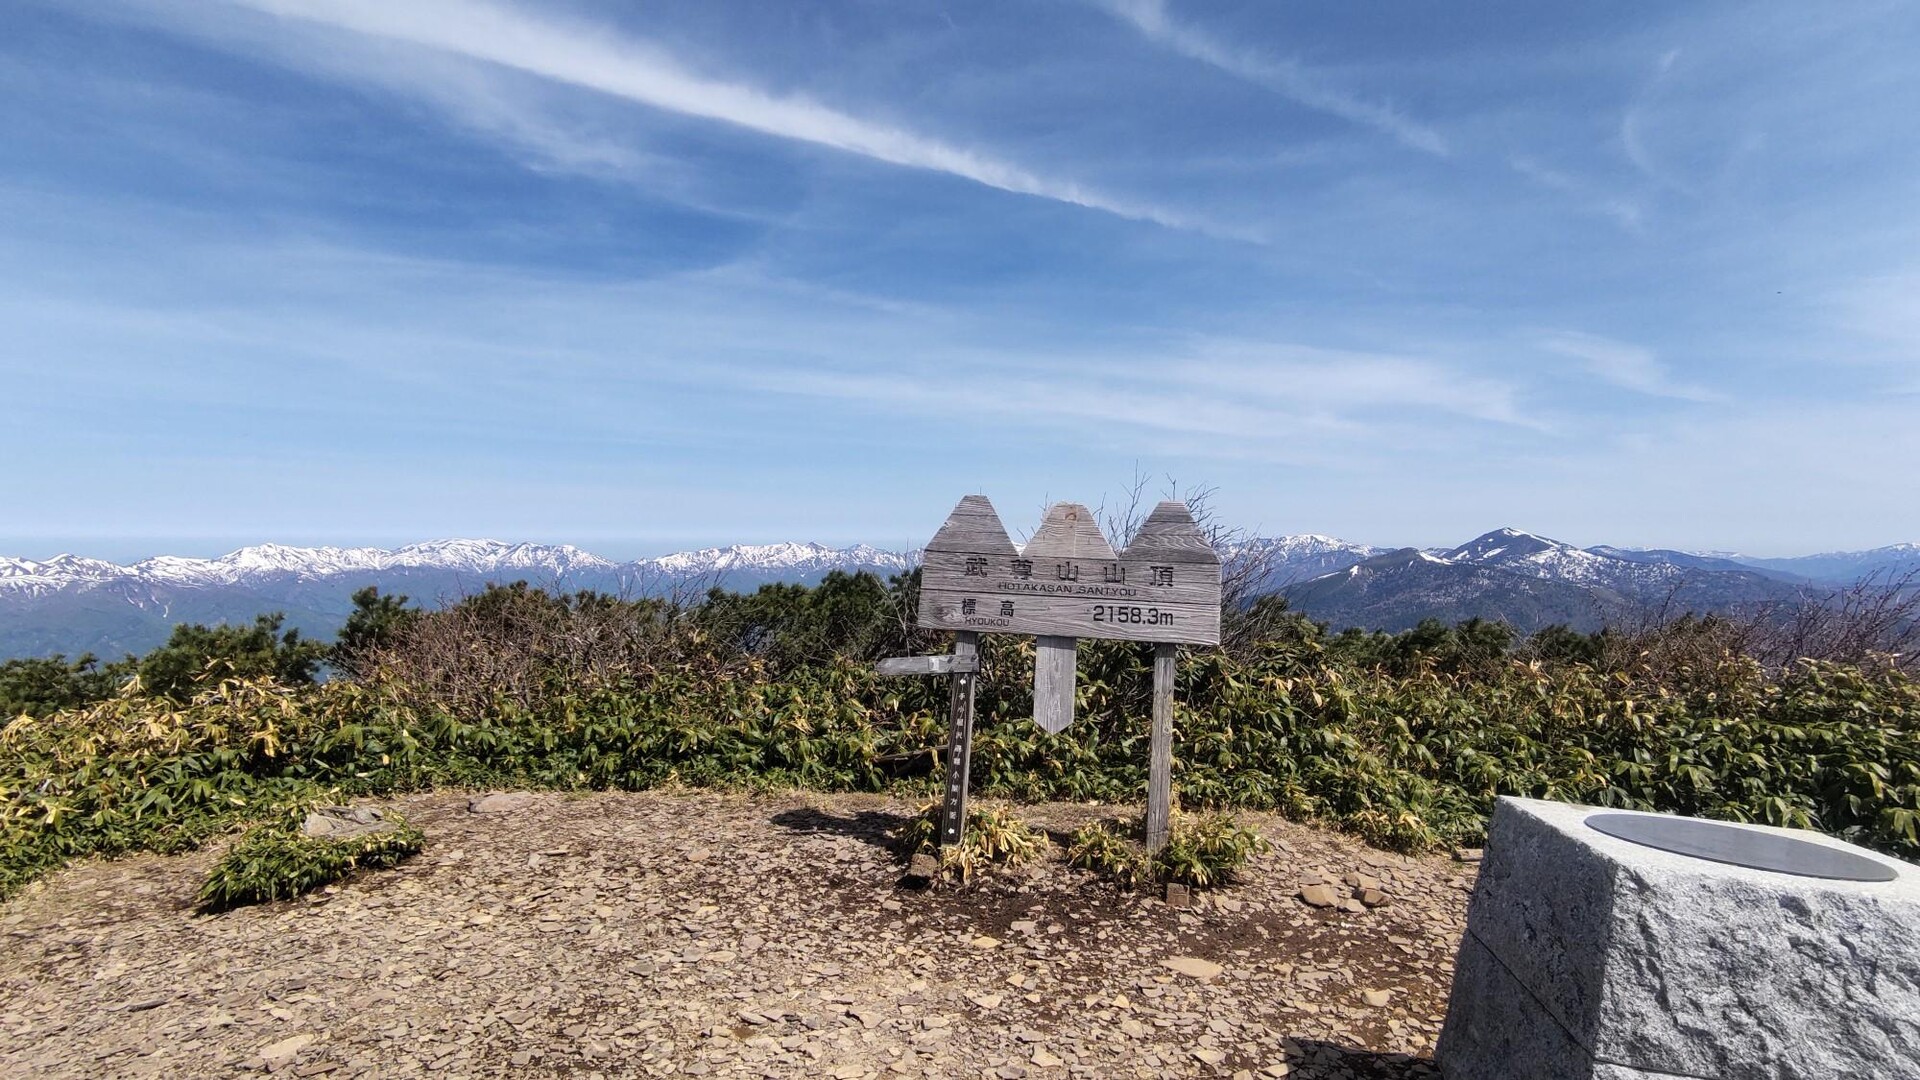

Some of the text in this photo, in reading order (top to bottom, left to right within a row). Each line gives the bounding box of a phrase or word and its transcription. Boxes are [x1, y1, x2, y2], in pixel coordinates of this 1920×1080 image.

[964, 557, 1174, 588] 武尊山山頂
[999, 581, 1137, 597] HOTAKASAN SANTYOU
[962, 598, 1015, 618] 標高
[1093, 605, 1174, 626] 2158.3m
